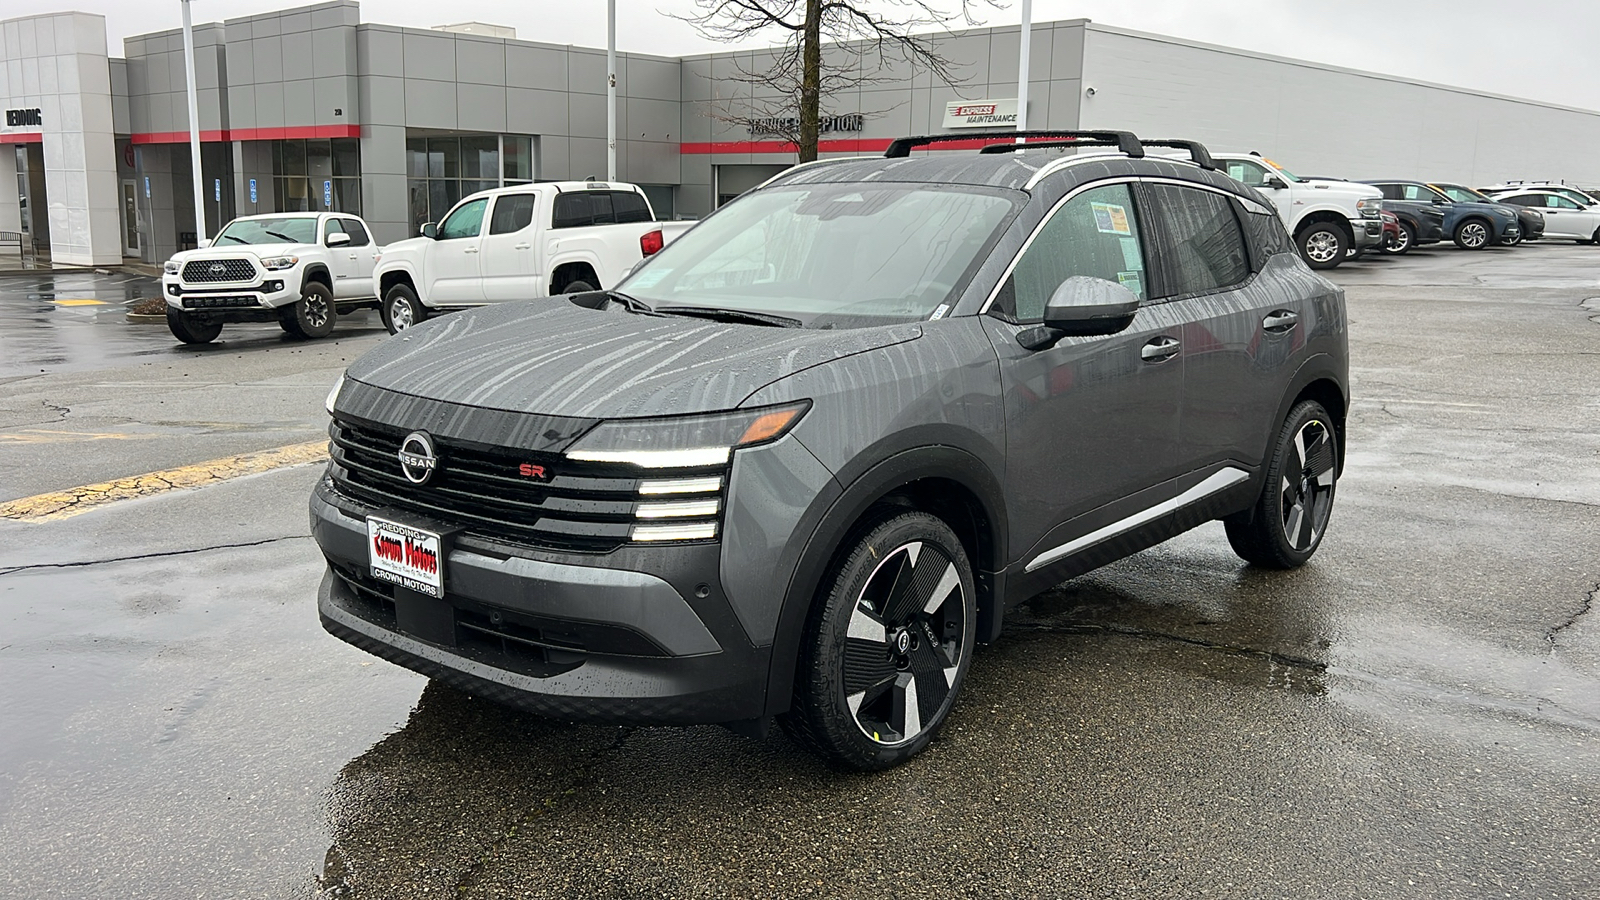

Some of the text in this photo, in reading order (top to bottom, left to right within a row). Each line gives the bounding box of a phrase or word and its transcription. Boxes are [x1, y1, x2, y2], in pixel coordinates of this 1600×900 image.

[6, 108, 42, 126] REDDING
[960, 106, 993, 115] EXPRESS
[966, 114, 1017, 123] MAINTENANCE
[399, 453, 435, 469] NISSAN
[519, 463, 545, 478] SR
[382, 522, 420, 539] REDDING
[373, 532, 437, 575] Crown Motors
[374, 568, 437, 595] CROWN MOTORS
